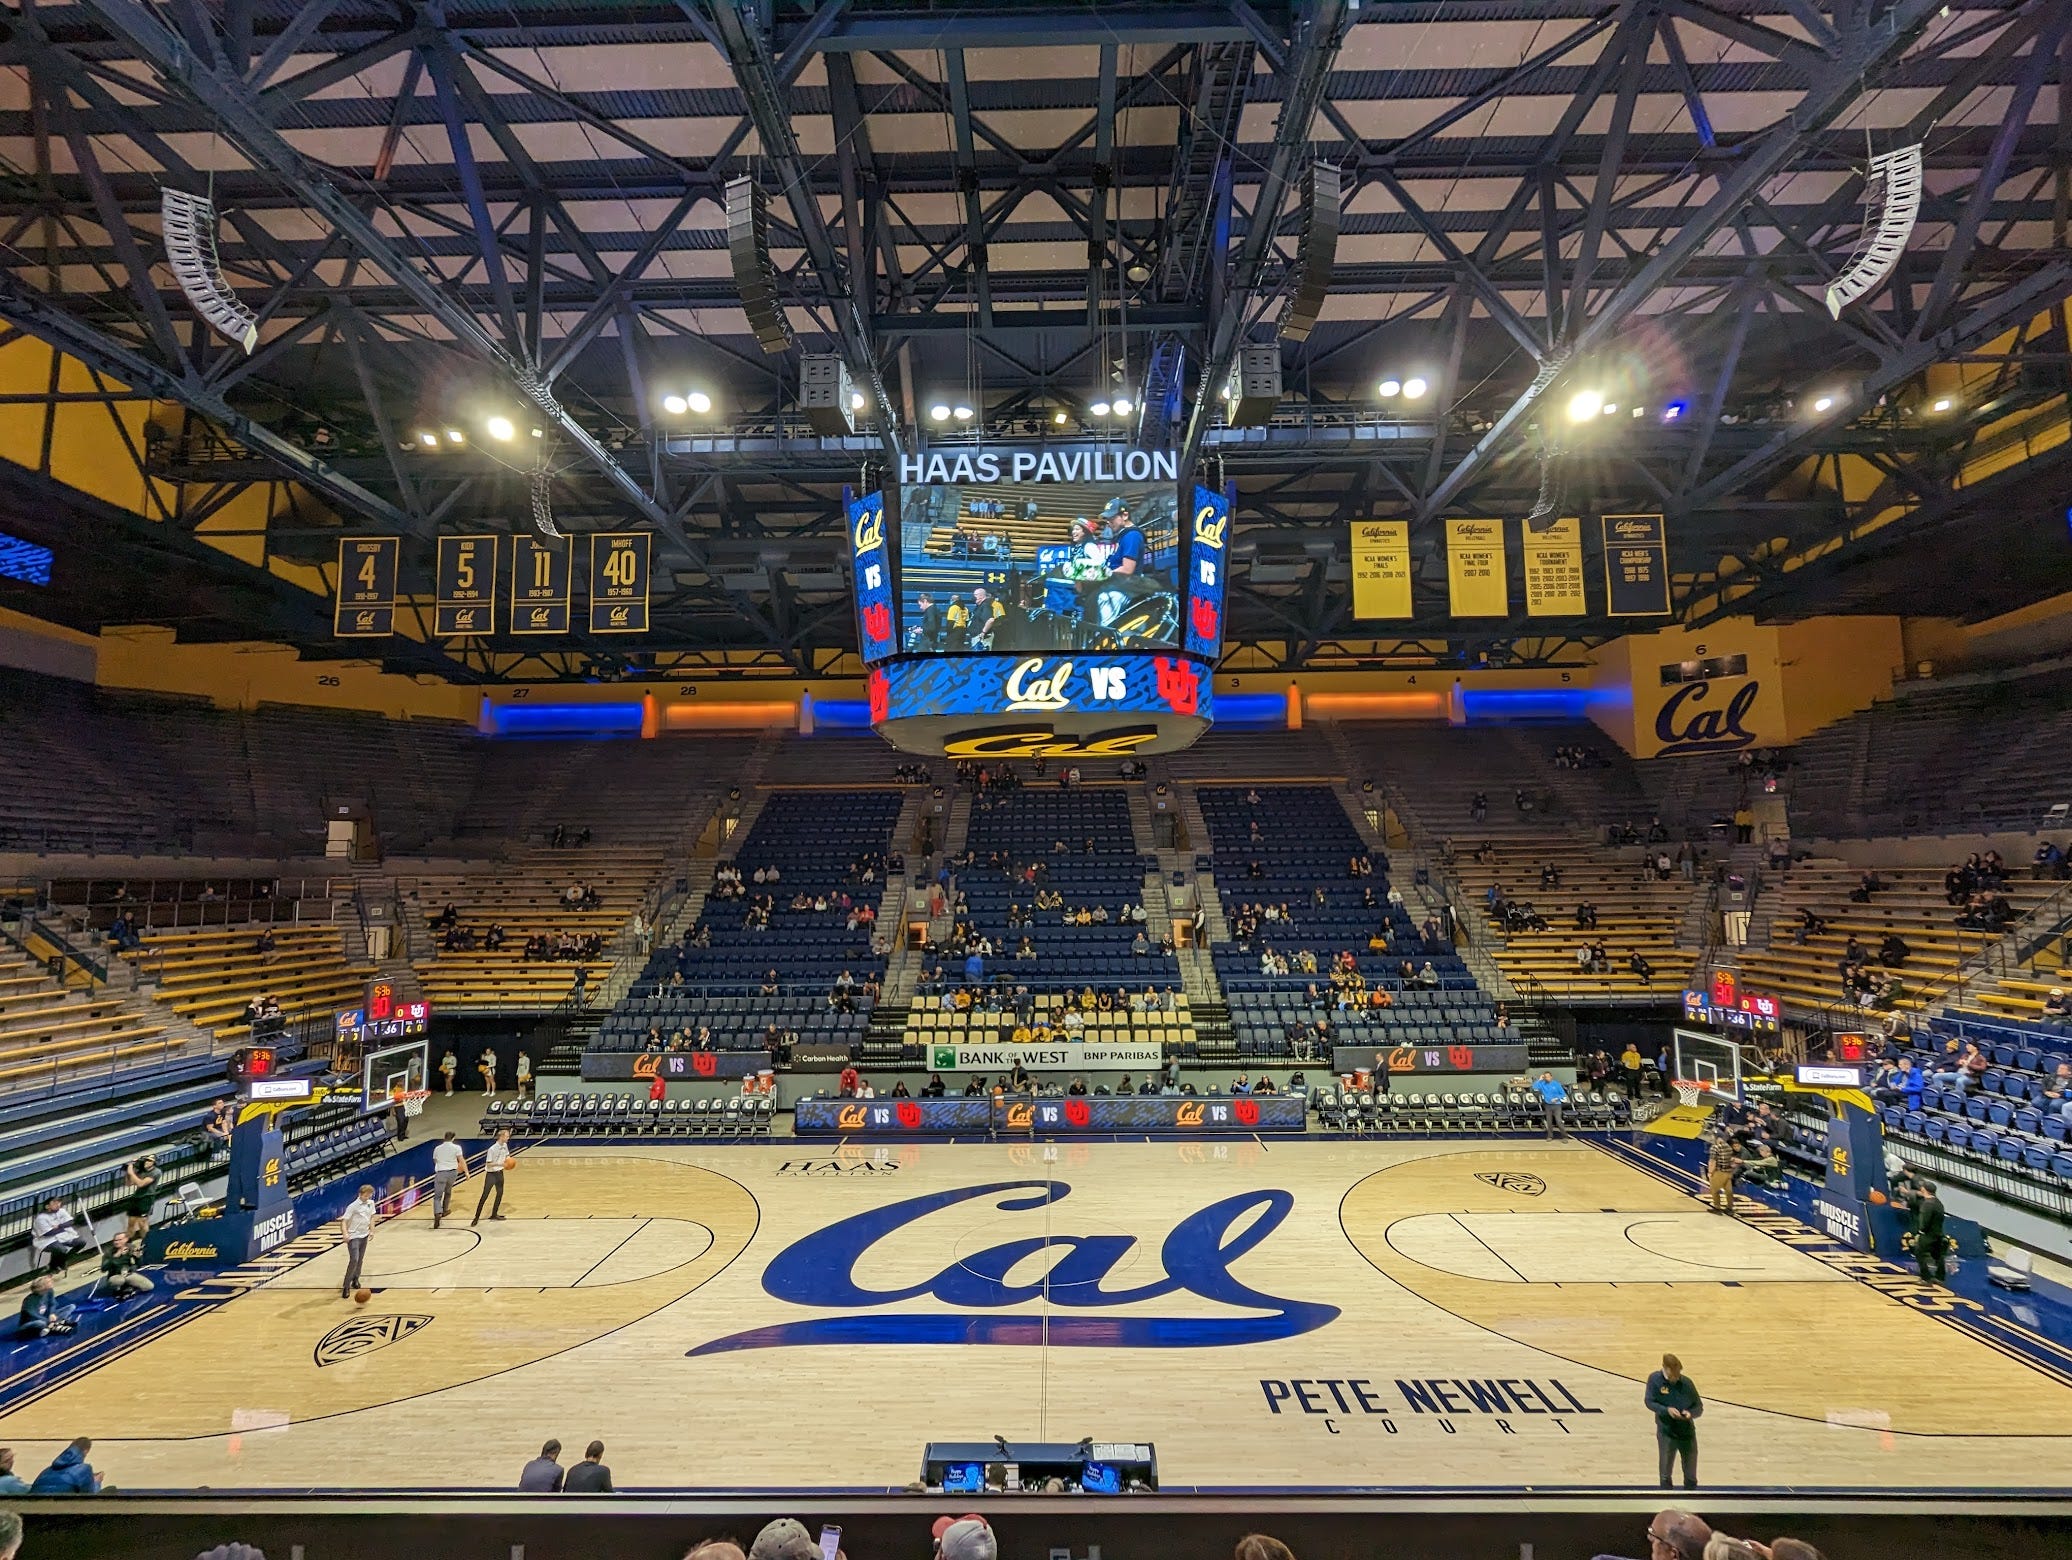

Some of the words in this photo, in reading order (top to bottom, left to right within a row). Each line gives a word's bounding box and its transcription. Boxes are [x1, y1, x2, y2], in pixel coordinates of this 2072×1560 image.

[901, 453, 1000, 483] HAAS
[1013, 451, 1178, 482] PAVILION
[855, 509, 883, 557] Cal
[1194, 506, 1227, 549] Cal
[358, 554, 376, 590] 4
[458, 552, 474, 587] 5
[535, 552, 550, 587] 11
[603, 550, 636, 586] 40
[1200, 559, 1215, 586] VS
[865, 564, 881, 590] VS
[357, 611, 376, 625] Cal
[456, 609, 474, 623] Cal
[531, 608, 550, 622] Cal
[611, 607, 629, 621] Cal
[1696, 644, 1706, 655] 6
[318, 675, 340, 687] 26
[1231, 679, 1240, 688] 3
[1408, 675, 1417, 684] 4
[1562, 673, 1570, 682] 5
[1005, 657, 1074, 712] Cal
[1089, 666, 1127, 700] VS
[512, 688, 529, 698] 27
[681, 687, 697, 696] 28
[1654, 681, 1759, 759] Cal
[944, 732, 1158, 760] Cal
[374, 985, 391, 997] 5:36
[1715, 984, 1733, 1005] 30
[1686, 991, 1702, 1006] Cal
[1742, 1000, 1749, 1009] 0
[371, 997, 390, 1019] 30
[397, 1008, 404, 1017] 0
[338, 1012, 358, 1027] Cal
[1700, 1013, 1706, 1021] 0
[417, 1024, 422, 1032] 0
[1768, 1021, 1774, 1030] 0
[253, 1051, 271, 1060] 5:36
[959, 1052, 1004, 1064] BANK
[1023, 1051, 1069, 1064] WEST
[1084, 1051, 1107, 1060] BNP
[1110, 1051, 1159, 1060] PARIBAS
[1388, 1047, 1416, 1071] Cal
[1424, 1051, 1440, 1066] VS
[633, 1054, 661, 1077] Cal
[669, 1057, 684, 1072] VS
[1344, 1095, 1353, 1104] G
[1379, 1094, 1388, 1103] G
[1411, 1094, 1420, 1103] G
[1445, 1094, 1454, 1103] G
[1477, 1094, 1485, 1103] G
[1510, 1094, 1519, 1103] G
[1575, 1093, 1584, 1102] G
[1609, 1092, 1617, 1101] G
[491, 1101, 501, 1110] G
[523, 1101, 533, 1110] G
[554, 1100, 564, 1110] G
[586, 1100, 596, 1110] G
[617, 1100, 626, 1109] G
[650, 1100, 659, 1109] G
[682, 1100, 691, 1109] G
[713, 1099, 722, 1109] G
[745, 1100, 754, 1109] G
[838, 1104, 868, 1128] Cal
[874, 1108, 890, 1124] VS
[1007, 1102, 1036, 1126] Cal
[1042, 1106, 1058, 1121] VS
[1176, 1102, 1205, 1126] Cal
[1211, 1105, 1227, 1121] VS
[780, 1161, 901, 1170] HAAS
[1820, 1200, 1859, 1231] MUSCLE
[253, 1210, 294, 1240] MUSCLE
[1827, 1219, 1854, 1244] MILK
[260, 1229, 287, 1251] MILK
[163, 1240, 218, 1261] California
[684, 1180, 1343, 1357] Cal
[1805, 1251, 1984, 1311] BEARS
[1259, 1379, 1389, 1414] PETE
[1394, 1379, 1605, 1414] NEWELL
[1324, 1418, 1571, 1434] COURT
